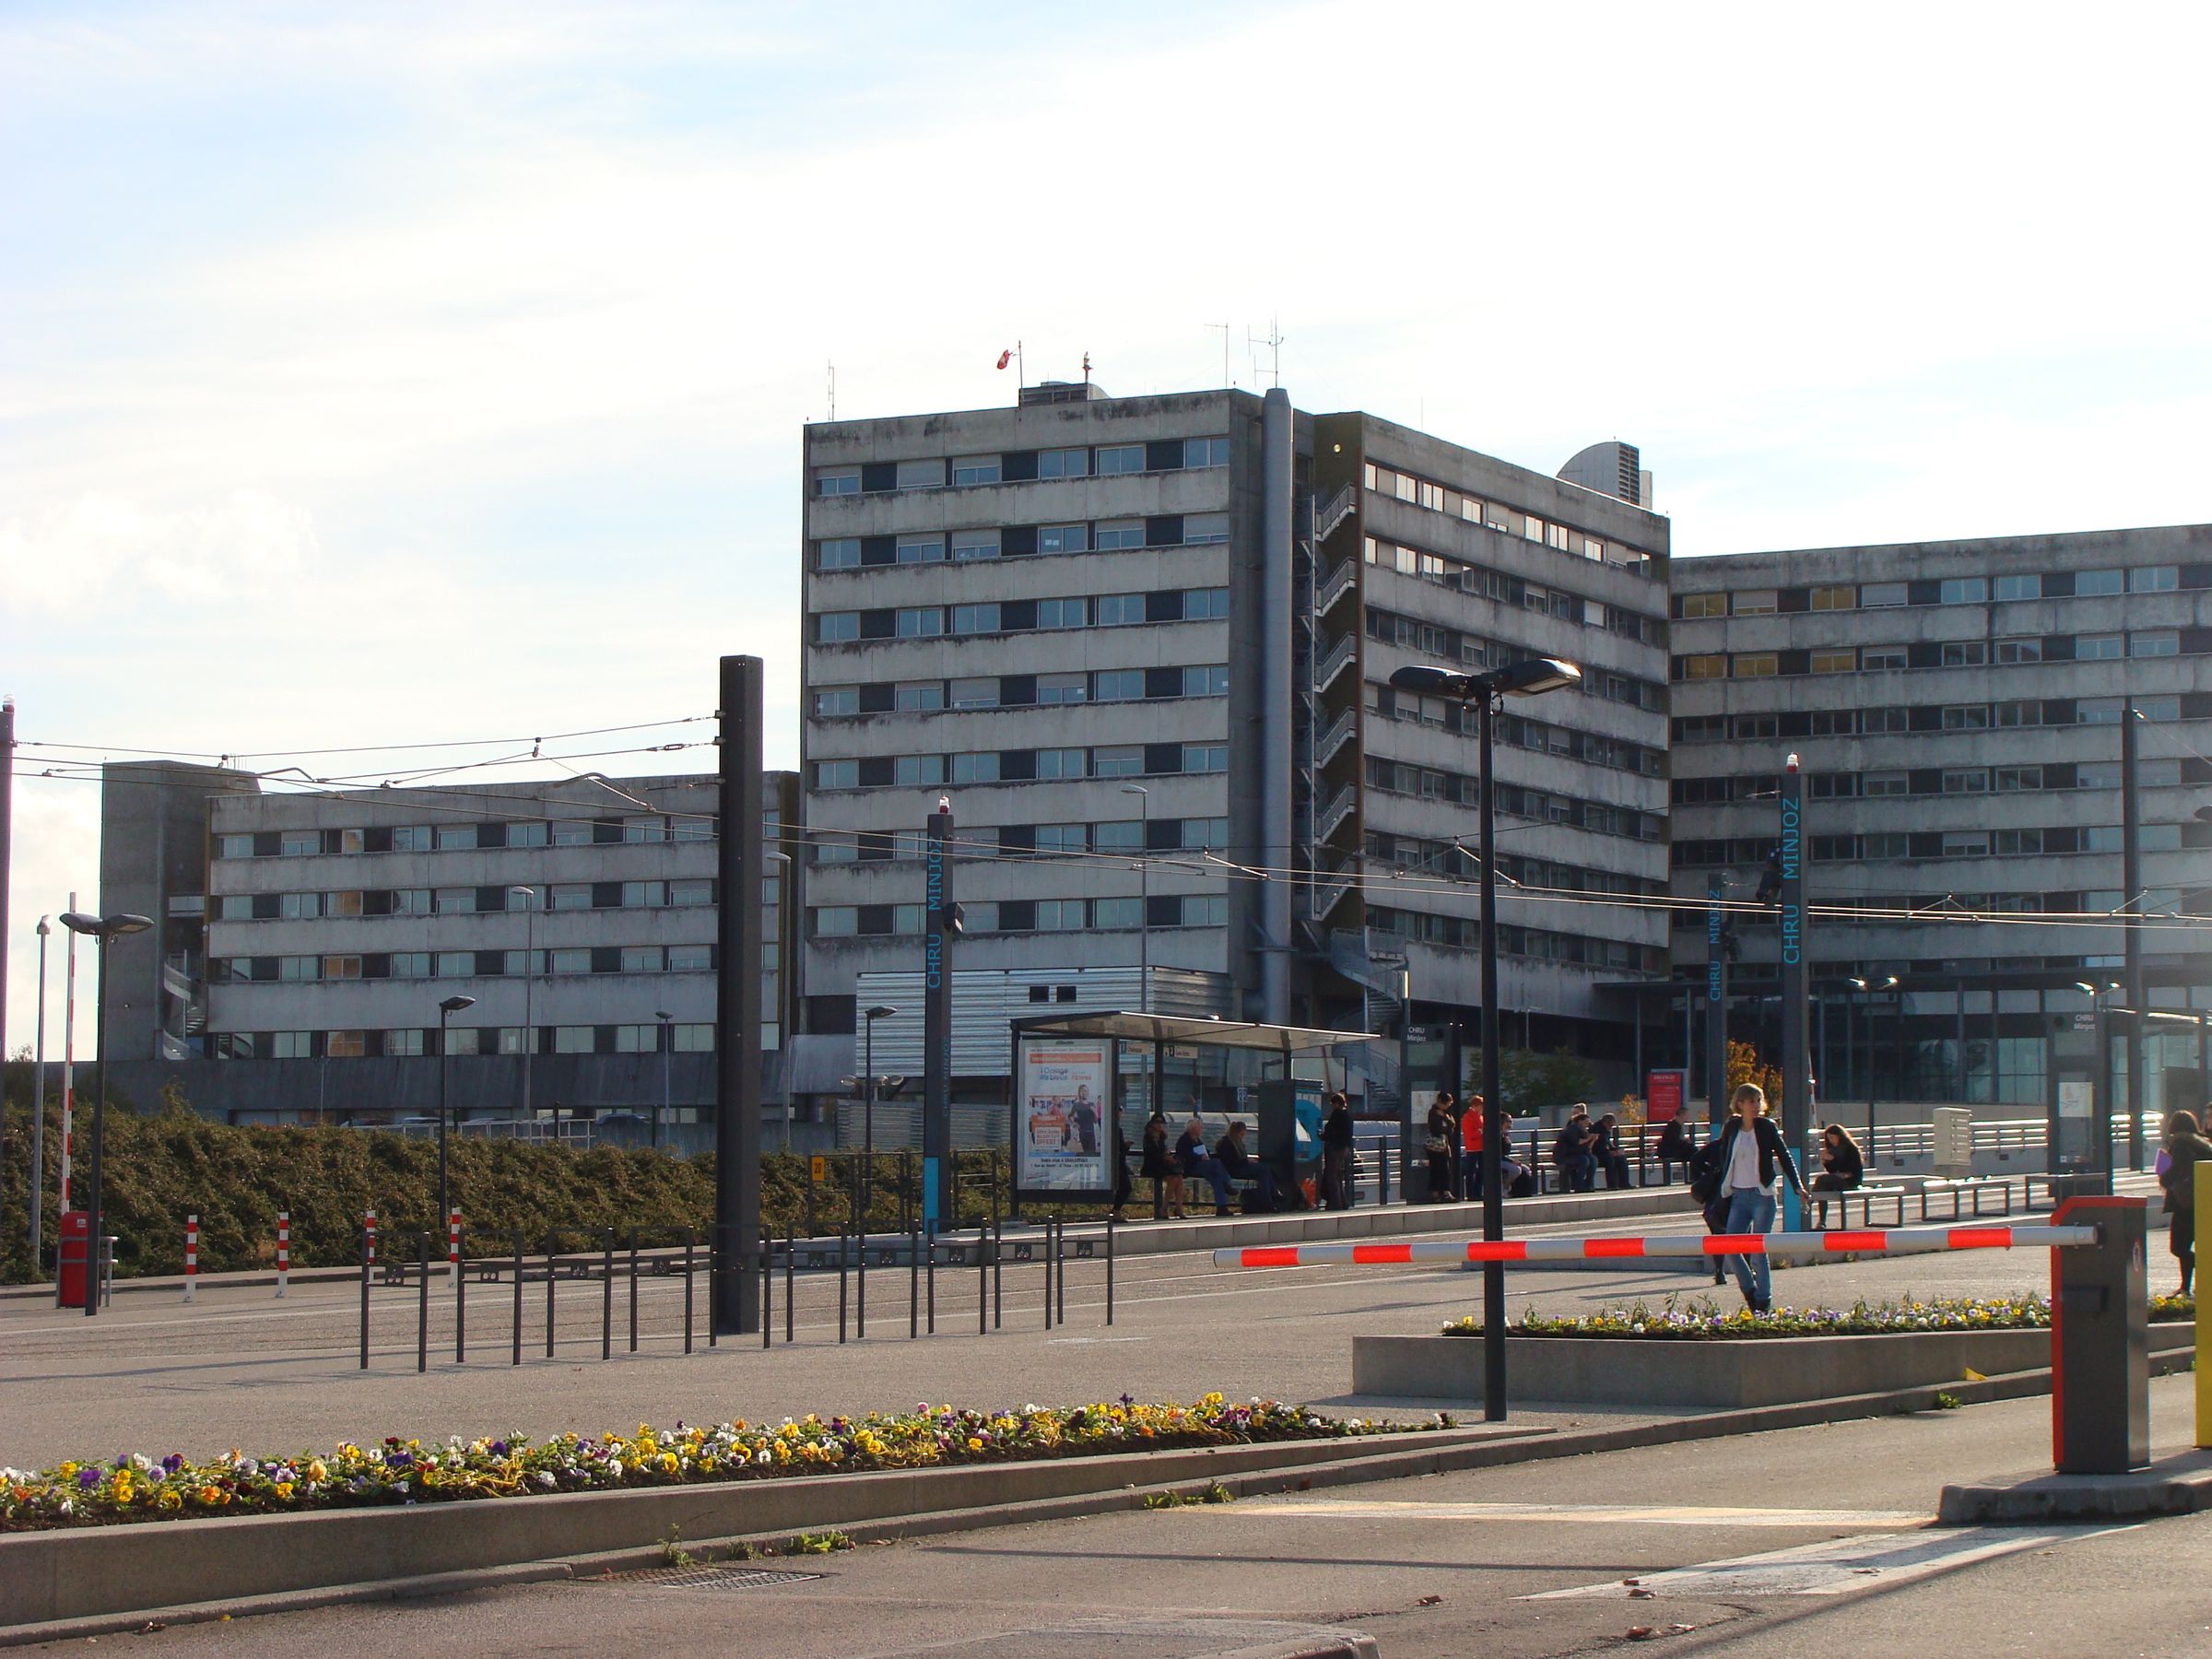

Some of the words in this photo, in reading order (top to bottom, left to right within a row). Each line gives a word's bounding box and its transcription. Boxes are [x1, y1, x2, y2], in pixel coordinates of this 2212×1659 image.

[1783, 797, 1799, 879] MINJOZ
[928, 835, 944, 911] MINJOZ
[927, 934, 942, 989] CHRU
[1783, 905, 1800, 965] CHRU
[1710, 960, 1722, 1001] CHRU
[1406, 1034, 1427, 1043] Minjoz
[814, 1162, 822, 1173] 20
